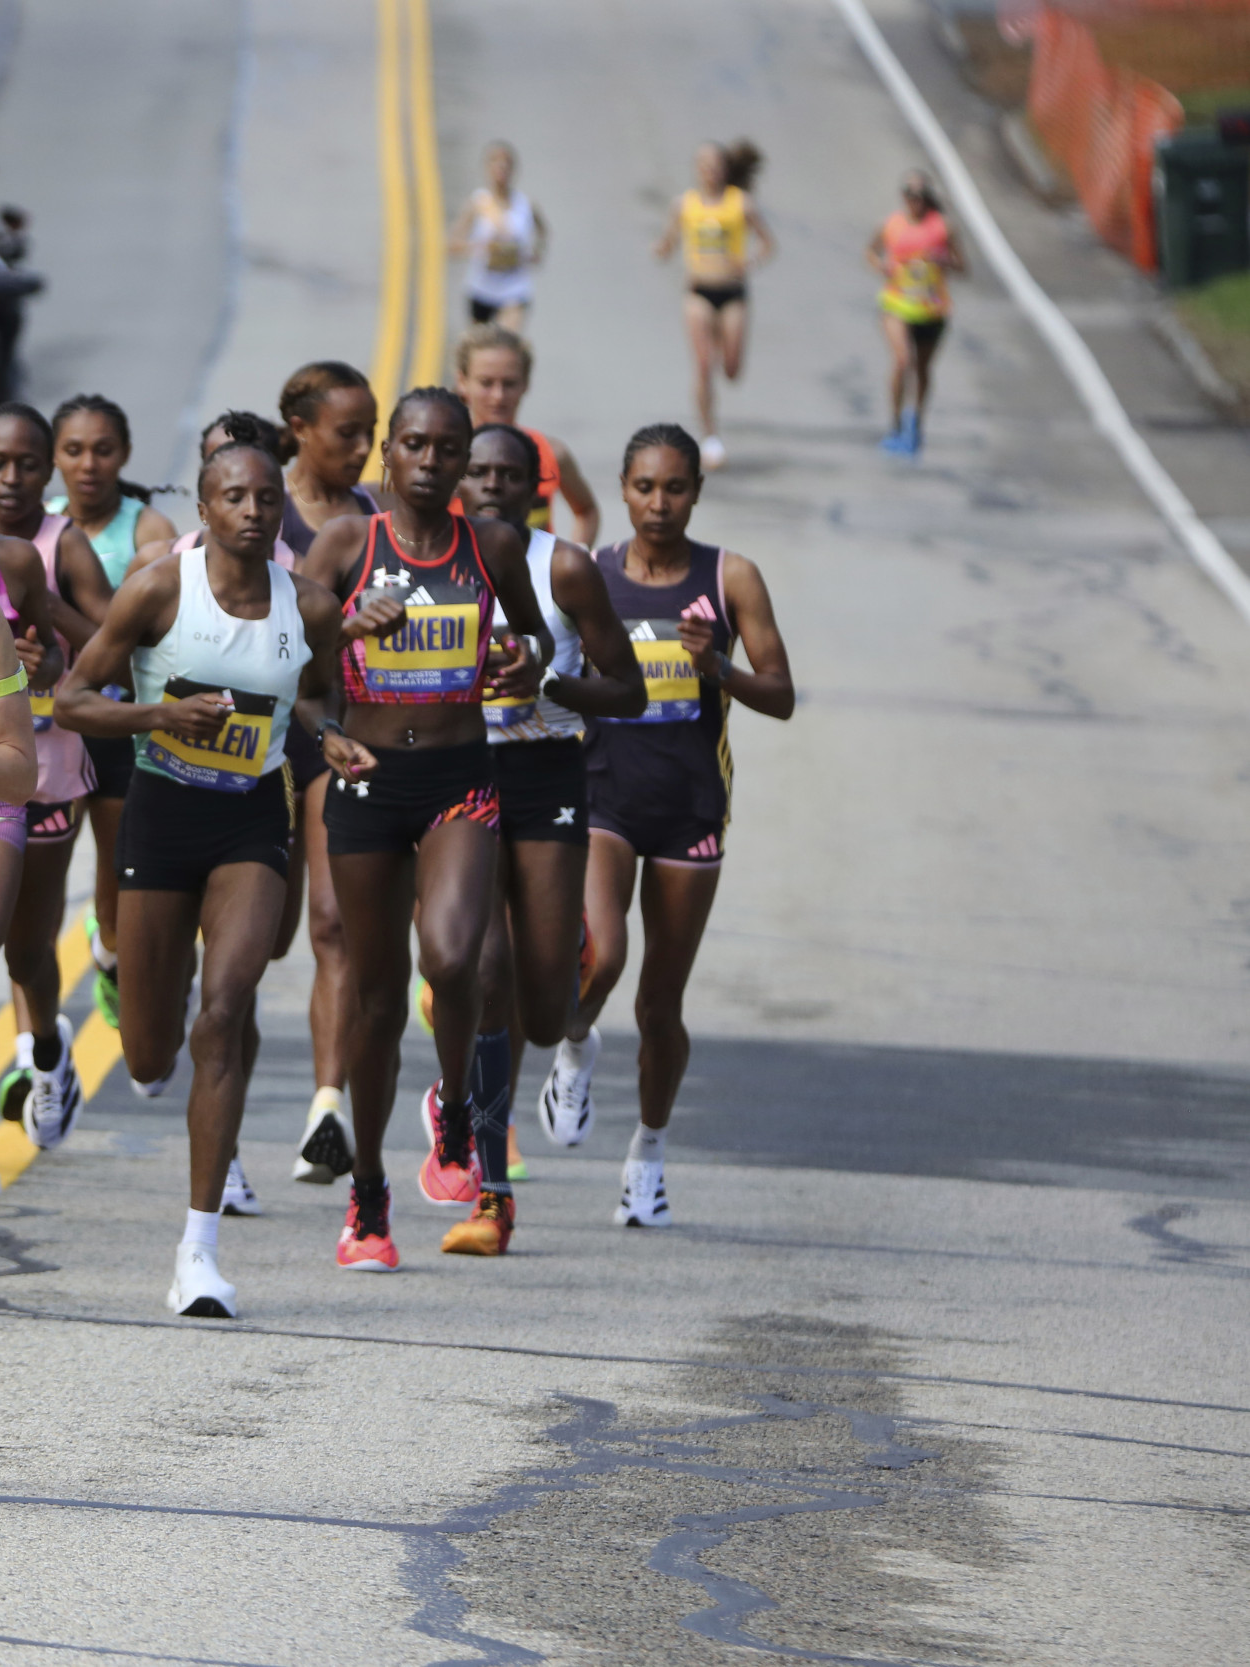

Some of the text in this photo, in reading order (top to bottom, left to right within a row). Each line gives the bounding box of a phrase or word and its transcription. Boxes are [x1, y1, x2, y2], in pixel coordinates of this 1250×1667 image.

[193, 632, 221, 643] OAC
[408, 670, 442, 679] BOSTON
[390, 677, 442, 686] MARATHON
[167, 760, 217, 784] MARATHON
[185, 764, 219, 777] BOSTON
